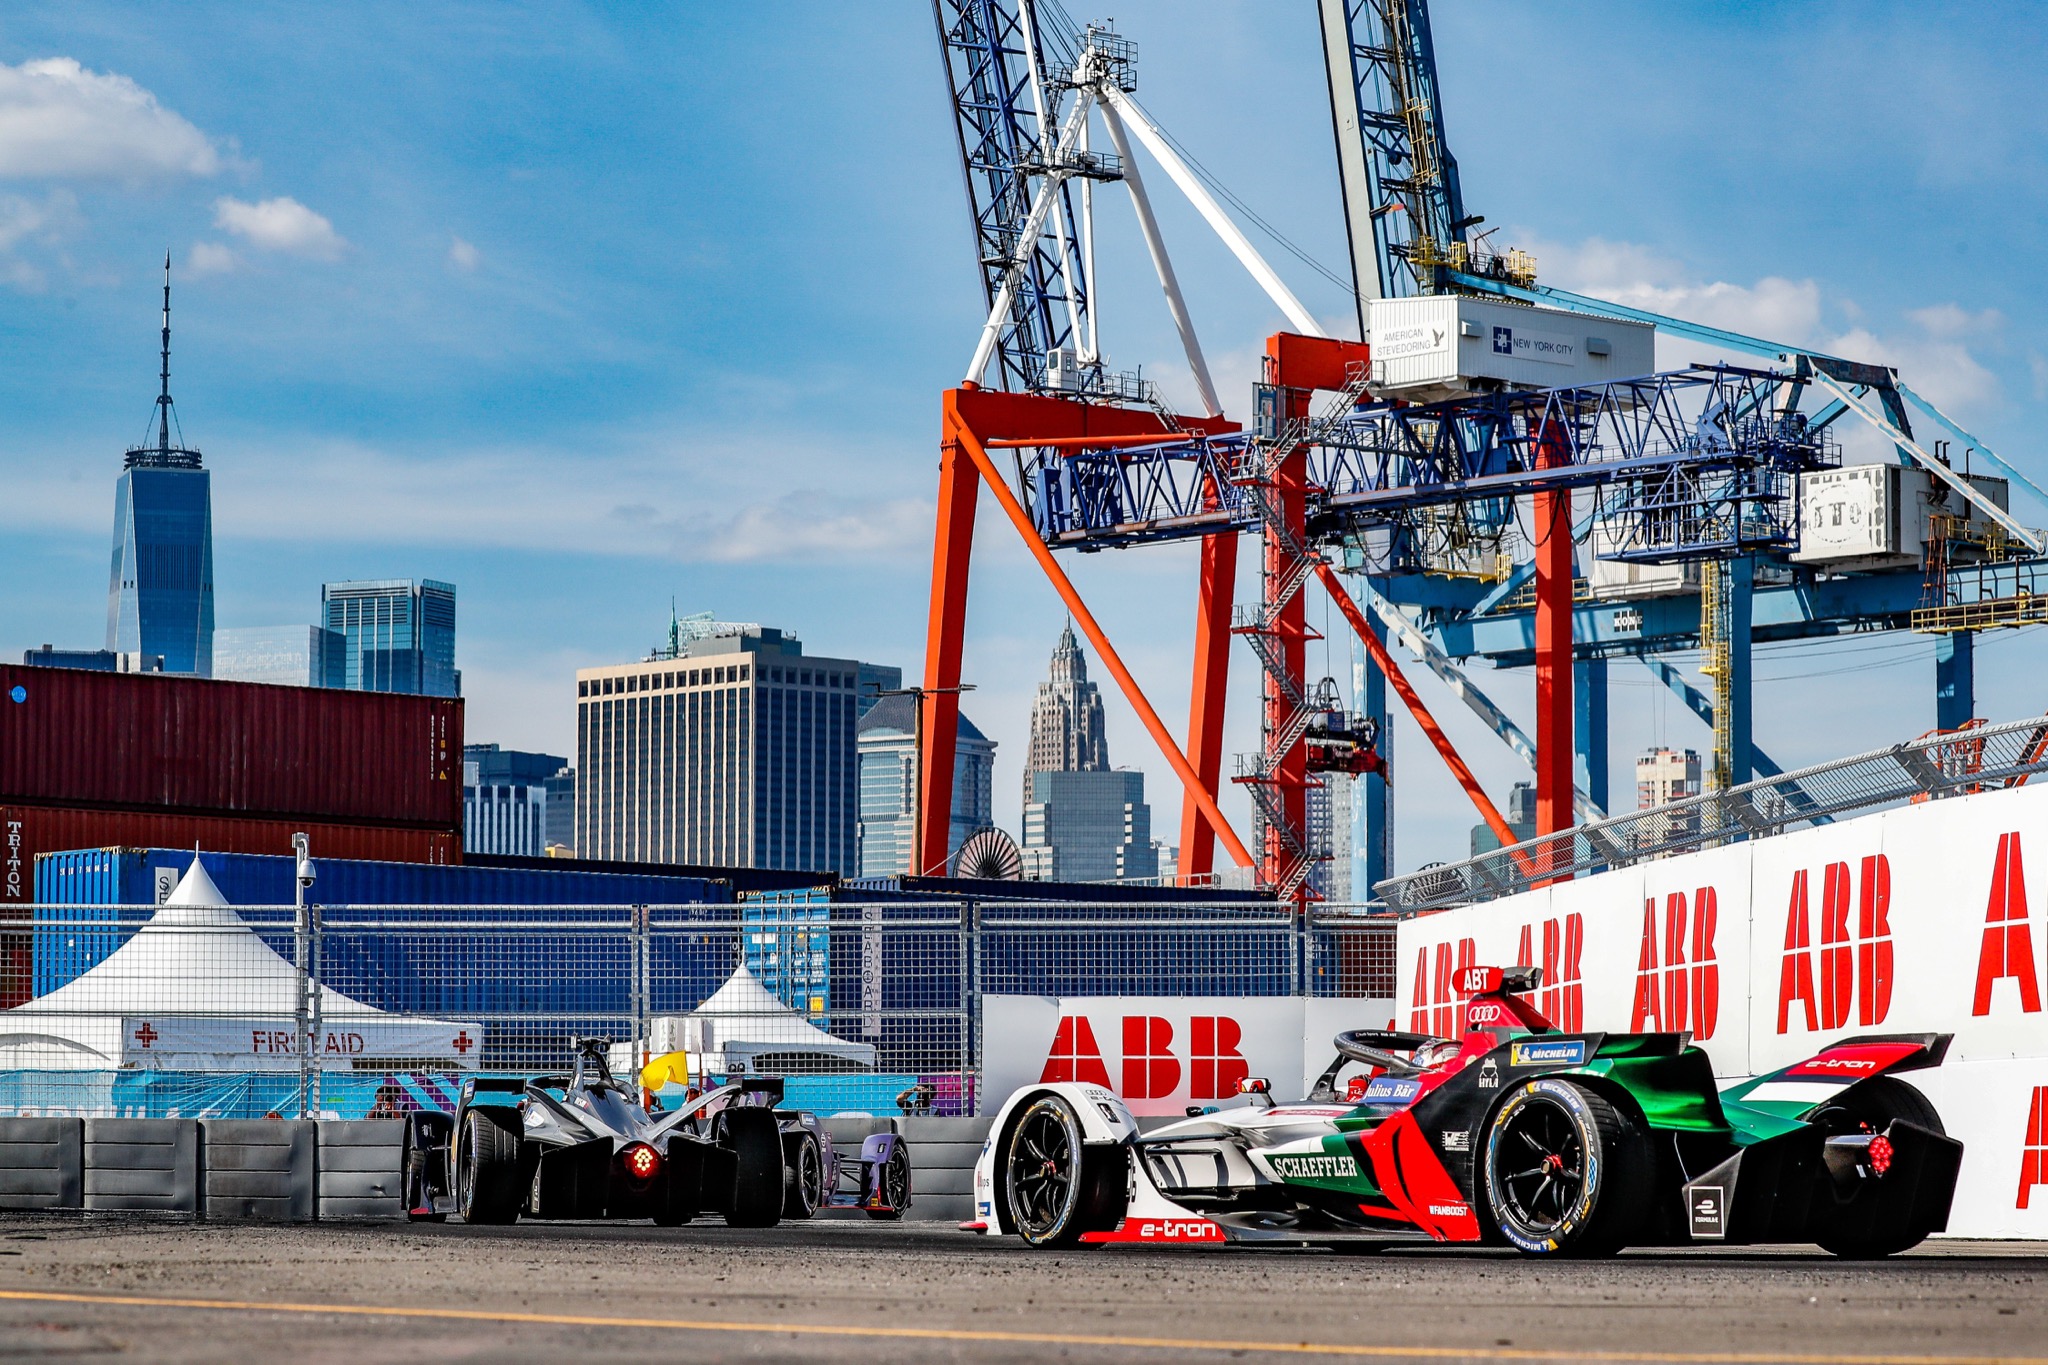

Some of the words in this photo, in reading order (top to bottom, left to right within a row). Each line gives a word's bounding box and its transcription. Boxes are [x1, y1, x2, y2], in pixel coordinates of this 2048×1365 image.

[1384, 328, 1423, 342] AMERICAN
[1377, 340, 1431, 357] STEVEDORING
[1513, 338, 1531, 349] NEW
[1534, 341, 1555, 353] YORK
[1556, 344, 1574, 355] CITY
[1614, 616, 1643, 627] KONE
[6, 821, 21, 897] TRITON
[1777, 854, 1894, 1035] ABB
[1516, 913, 1583, 1035] ABB
[1630, 887, 1718, 1042] ABB
[1464, 968, 1489, 991] ABT
[252, 1031, 315, 1054] FIRT
[324, 1033, 364, 1055] AID
[1039, 1016, 1249, 1098] ABB
[1532, 1048, 1579, 1059] MICHELIN
[1805, 1059, 1876, 1069] e-tron
[1363, 1083, 1393, 1100] Julius
[1393, 1083, 1415, 1098] Bär
[1478, 1077, 1499, 1088] HYLA
[1541, 1082, 1580, 1110] MICHELIN
[1274, 1156, 1358, 1177] SCHAEFFLER
[1434, 1205, 1468, 1216] FANBOOST
[1140, 1219, 1216, 1237] e-tron
[1504, 1228, 1542, 1251] MICHELIN
